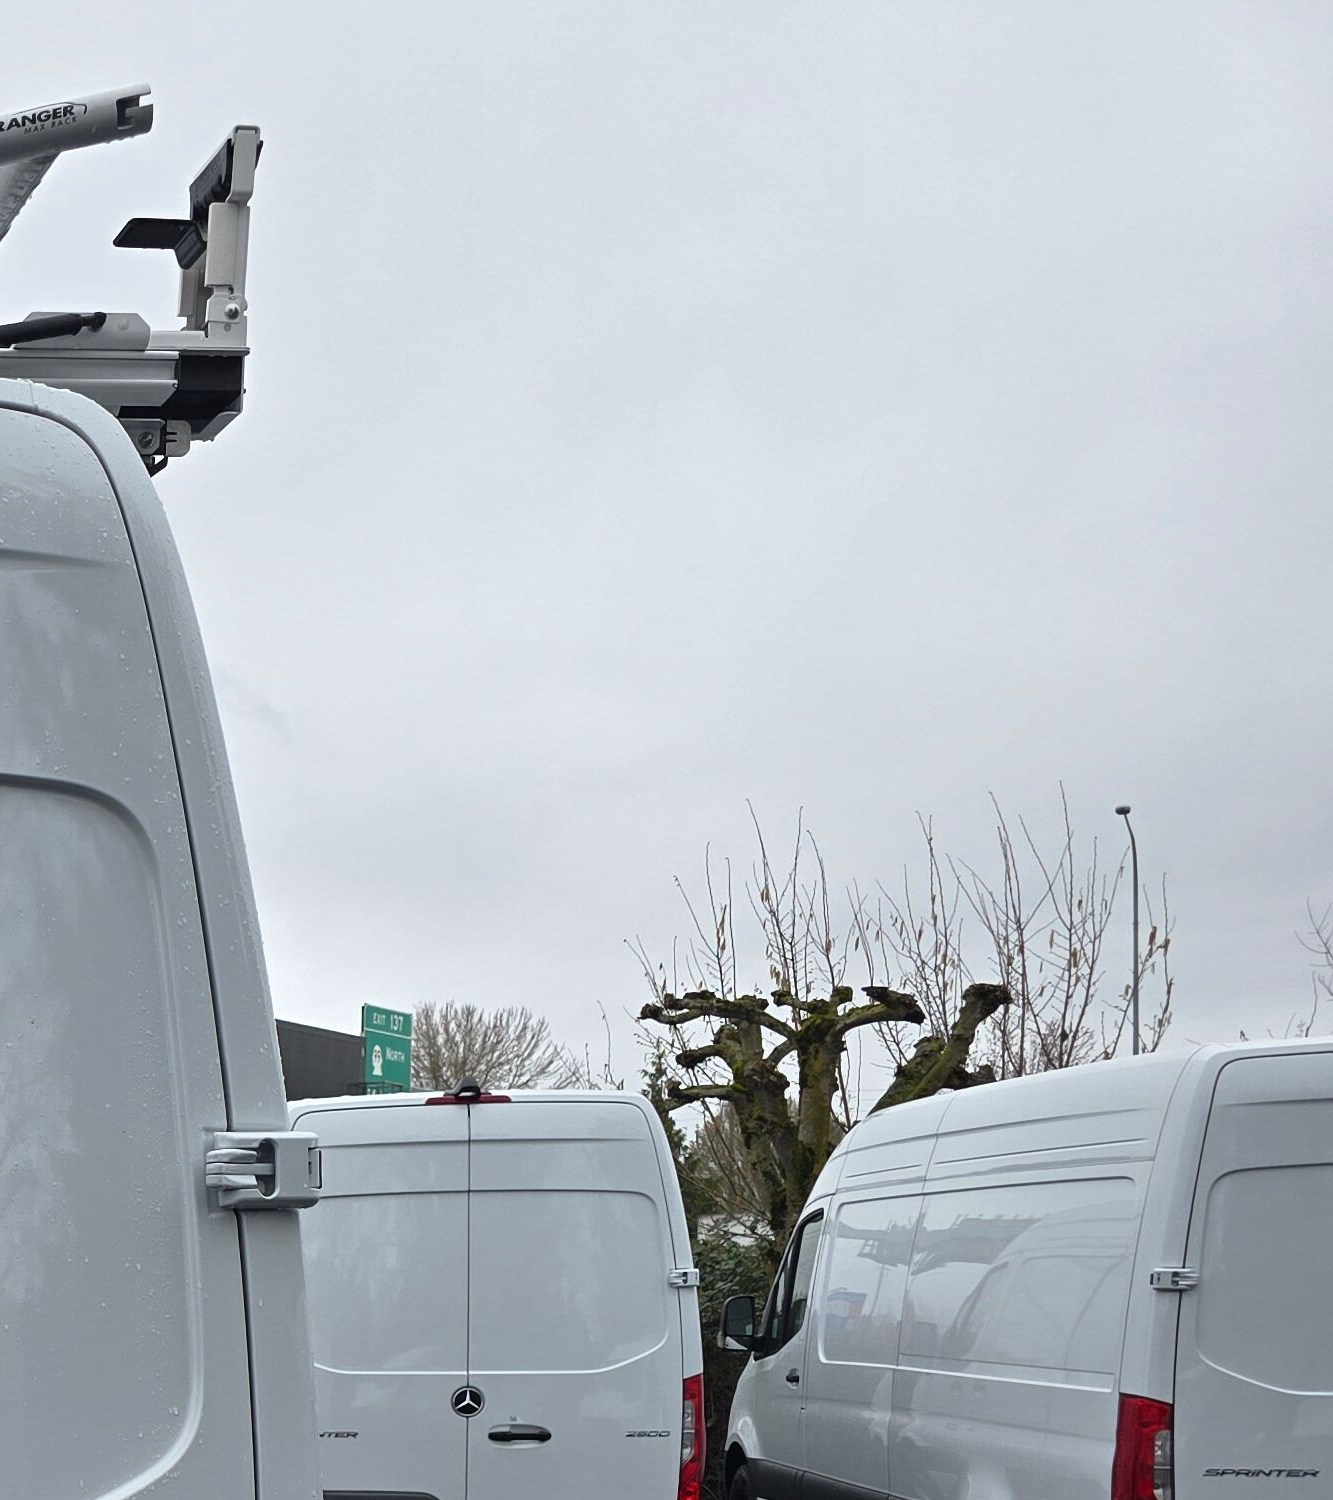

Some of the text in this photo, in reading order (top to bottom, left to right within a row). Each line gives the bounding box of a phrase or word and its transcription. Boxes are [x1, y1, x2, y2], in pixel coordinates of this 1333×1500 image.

[24, 116, 76, 134] MAX RACK
[373, 1012, 403, 1032] EXIT 137
[1202, 1468, 1320, 1478] SPRINTER
